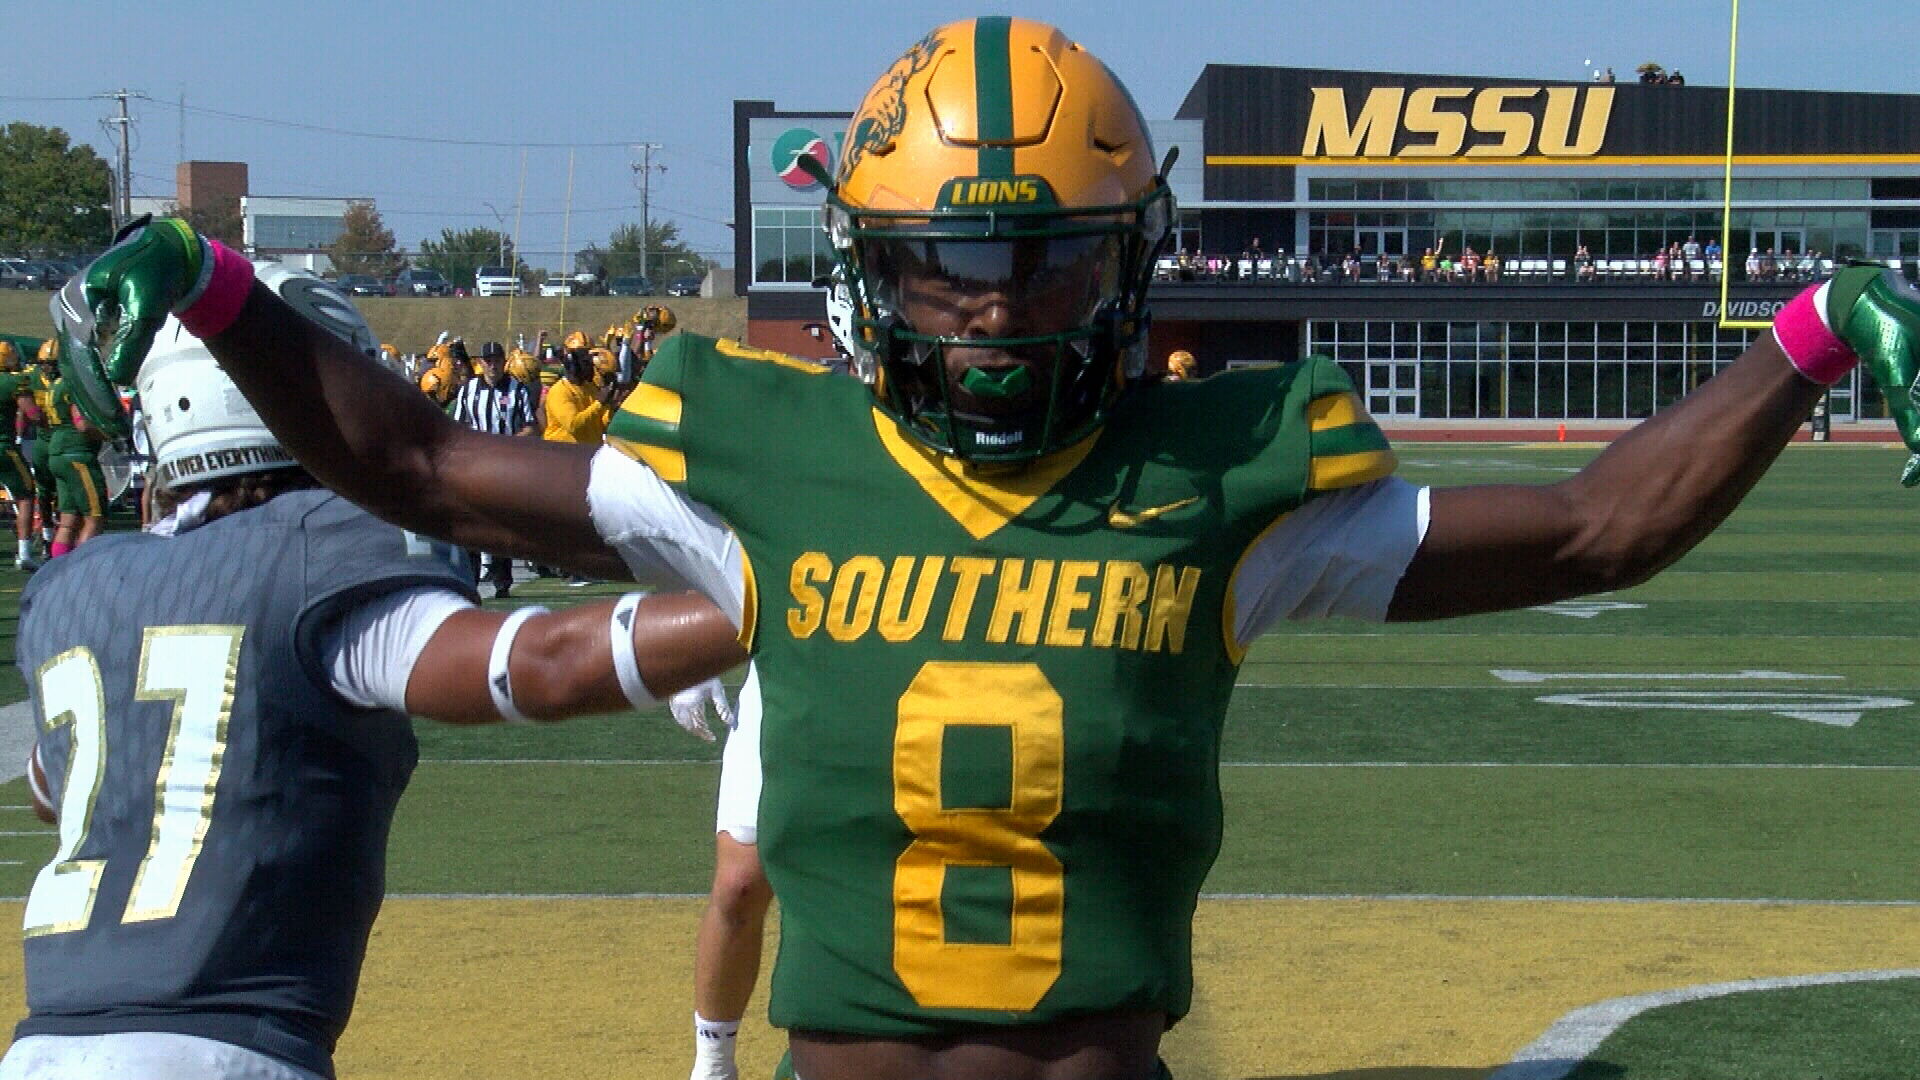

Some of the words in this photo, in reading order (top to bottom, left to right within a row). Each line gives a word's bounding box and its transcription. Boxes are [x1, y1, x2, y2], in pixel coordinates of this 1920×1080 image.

[1302, 87, 1615, 157] MSSU
[951, 181, 1038, 204] LIONS
[976, 431, 1023, 445] Riddell
[787, 552, 1202, 654] SOUTHERN
[23, 625, 246, 938] 27
[893, 661, 1064, 1011] 8
